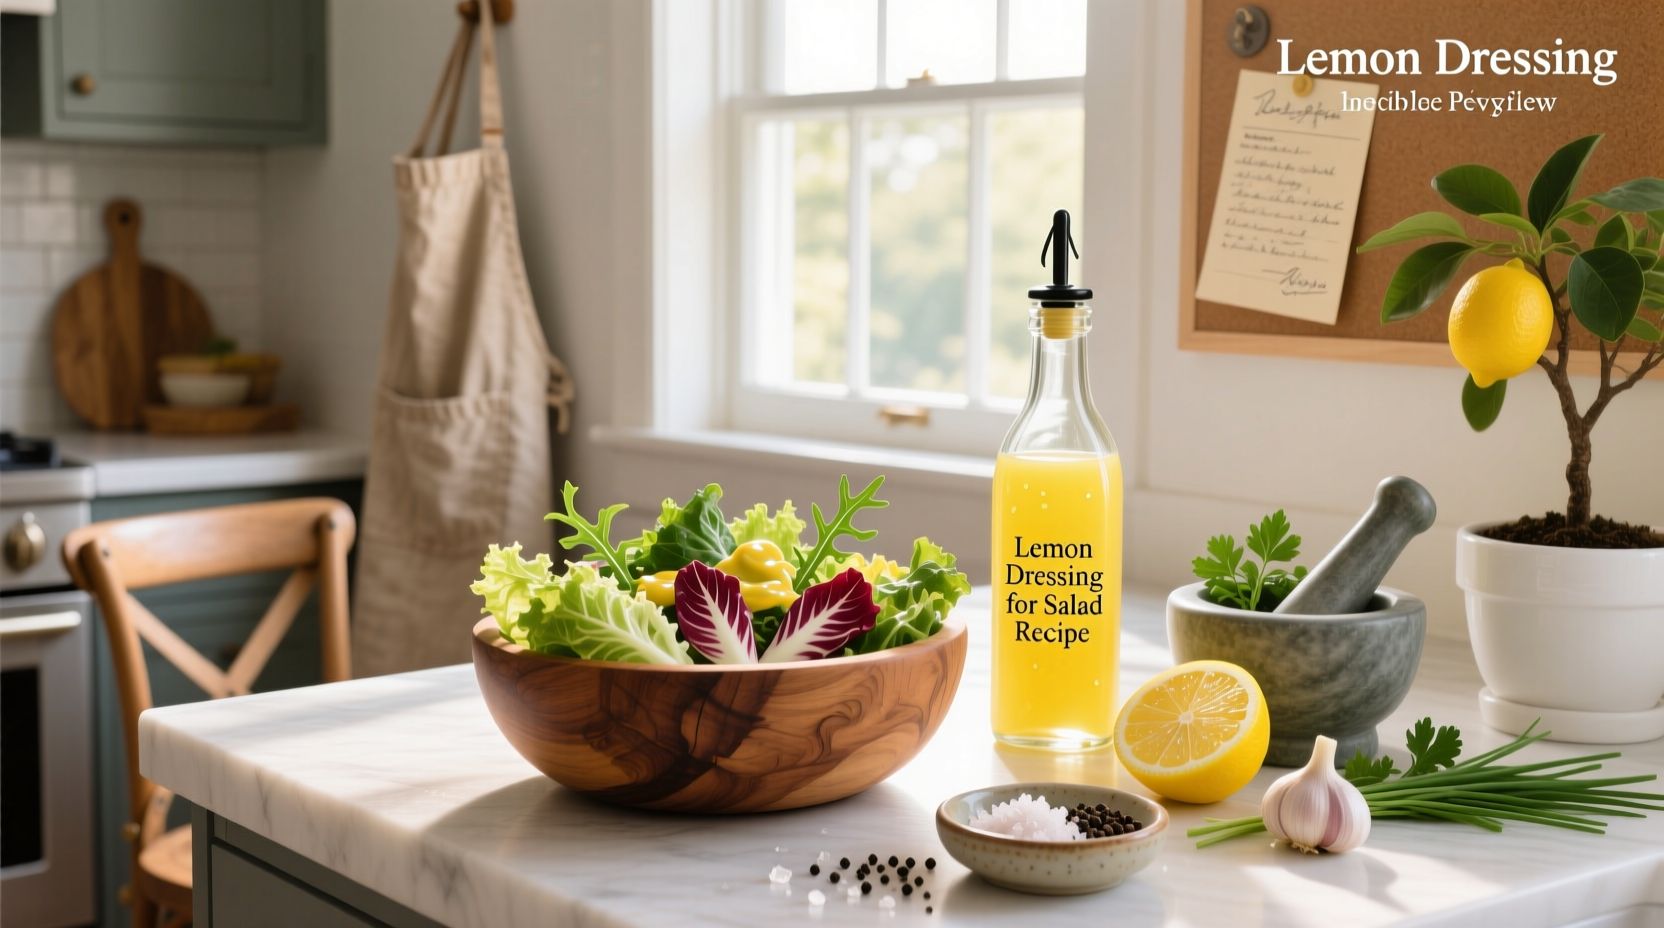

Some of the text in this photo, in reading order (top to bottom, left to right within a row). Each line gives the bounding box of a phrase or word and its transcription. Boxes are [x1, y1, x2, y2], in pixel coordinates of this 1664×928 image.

[1014, 536, 1093, 558] Lemon
[1005, 564, 1104, 593] Dressing
[1006, 592, 1103, 615] for Salad
[1015, 621, 1090, 649] Recipe
